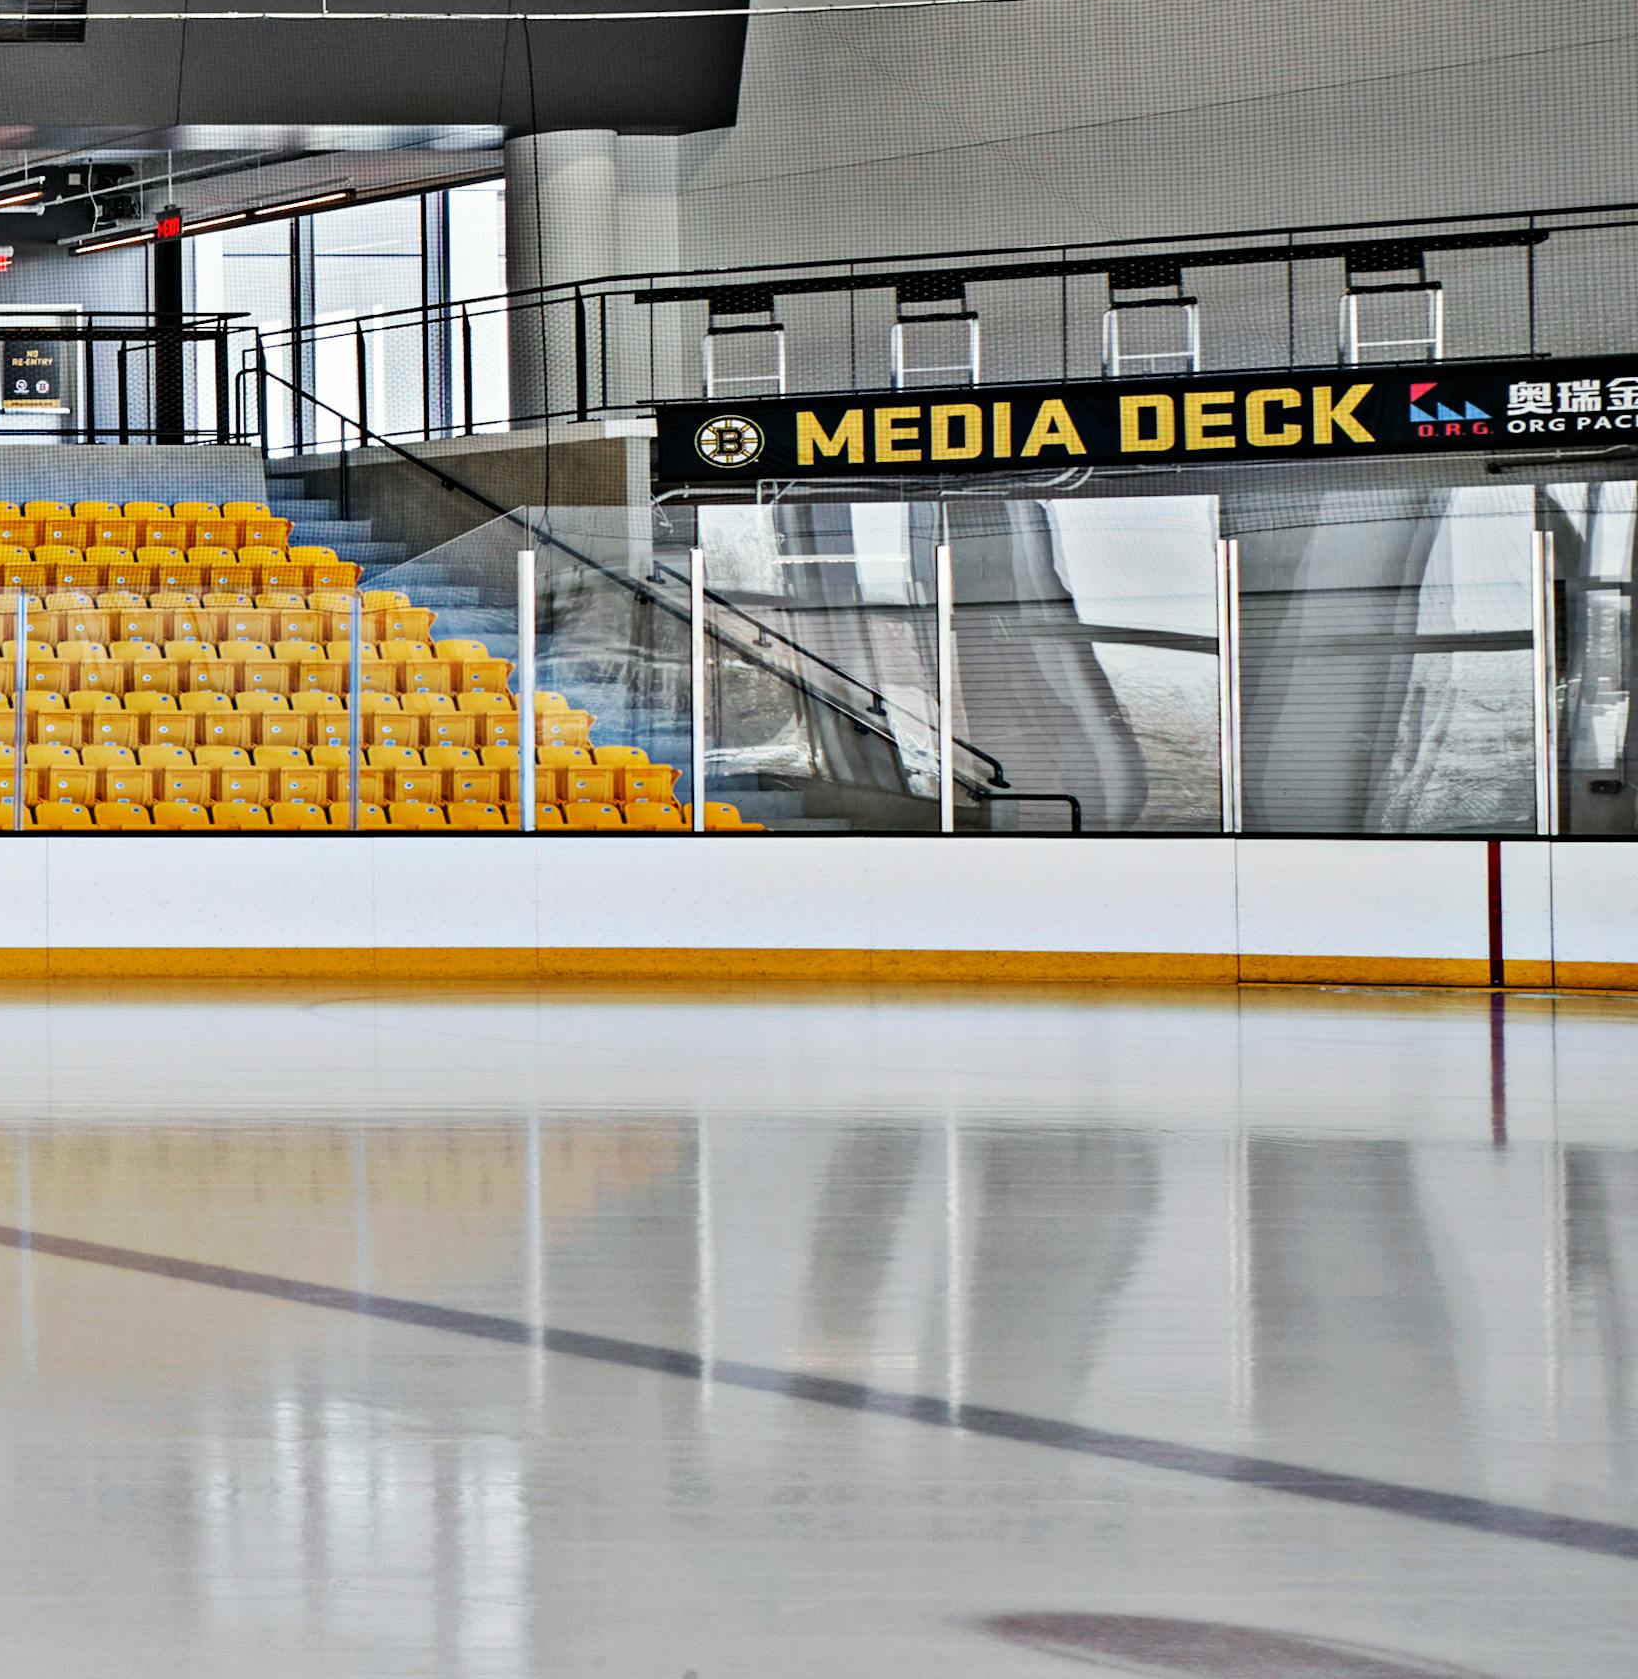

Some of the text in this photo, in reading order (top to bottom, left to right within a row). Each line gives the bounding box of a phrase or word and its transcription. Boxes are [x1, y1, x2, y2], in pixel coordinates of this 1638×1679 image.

[26, 349, 39, 358] NO
[796, 383, 1375, 466] MEDIA DECK
[1507, 415, 1638, 434] ORG PAC
